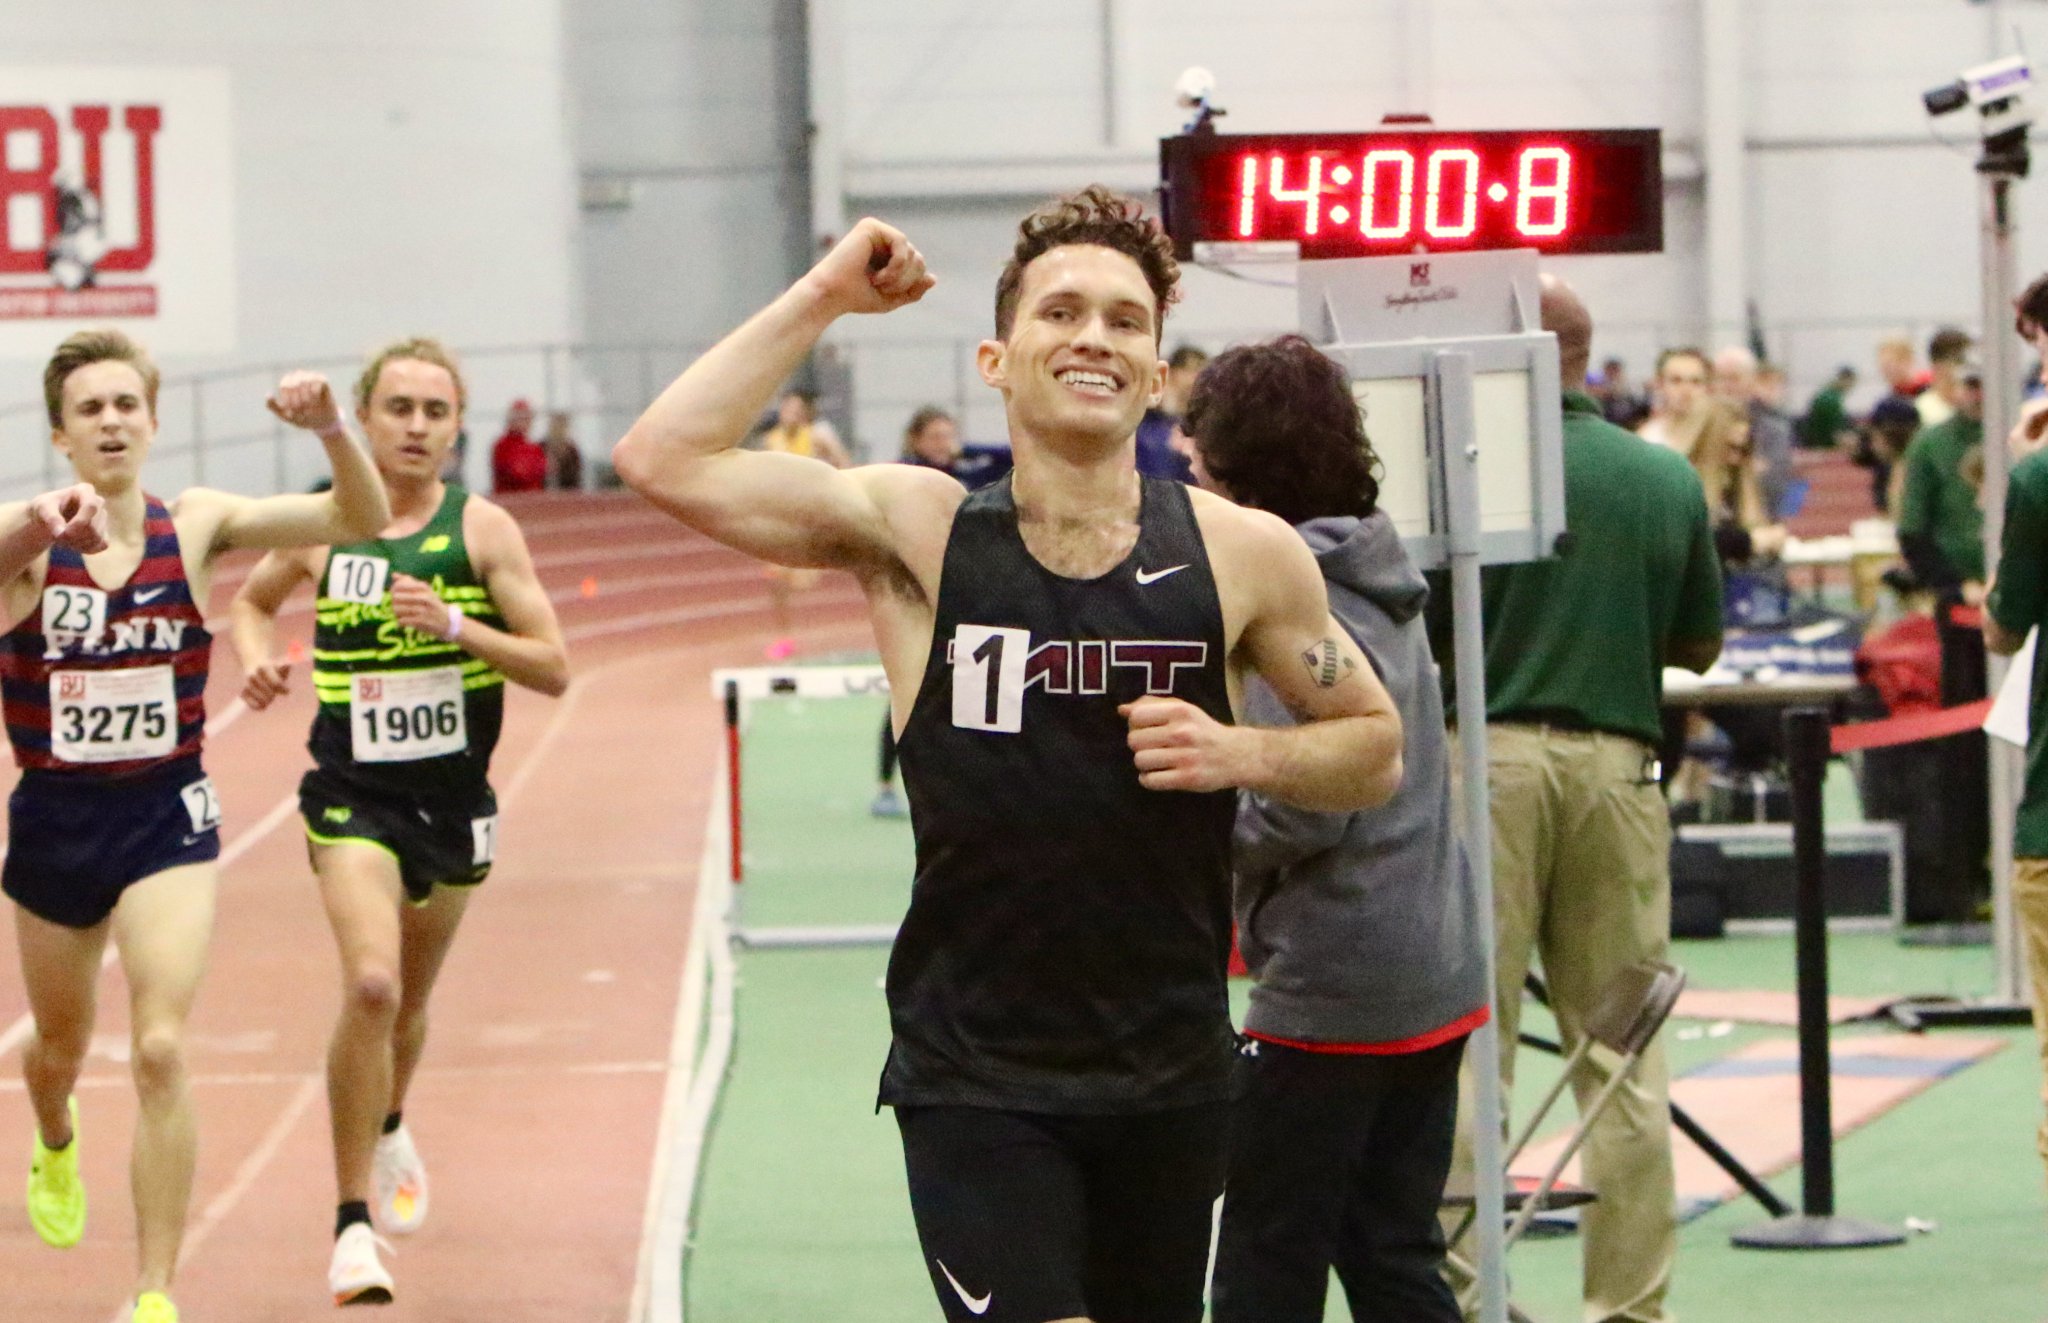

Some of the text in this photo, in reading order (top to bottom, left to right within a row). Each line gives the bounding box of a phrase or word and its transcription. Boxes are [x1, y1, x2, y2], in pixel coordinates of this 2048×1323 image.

[0, 105, 161, 273] BU
[342, 560, 376, 598] 10
[51, 590, 95, 633] 23
[972, 634, 1005, 725] 1
[62, 702, 165, 743] 3275
[362, 701, 458, 743] 1906
[193, 786, 221, 826] 2
